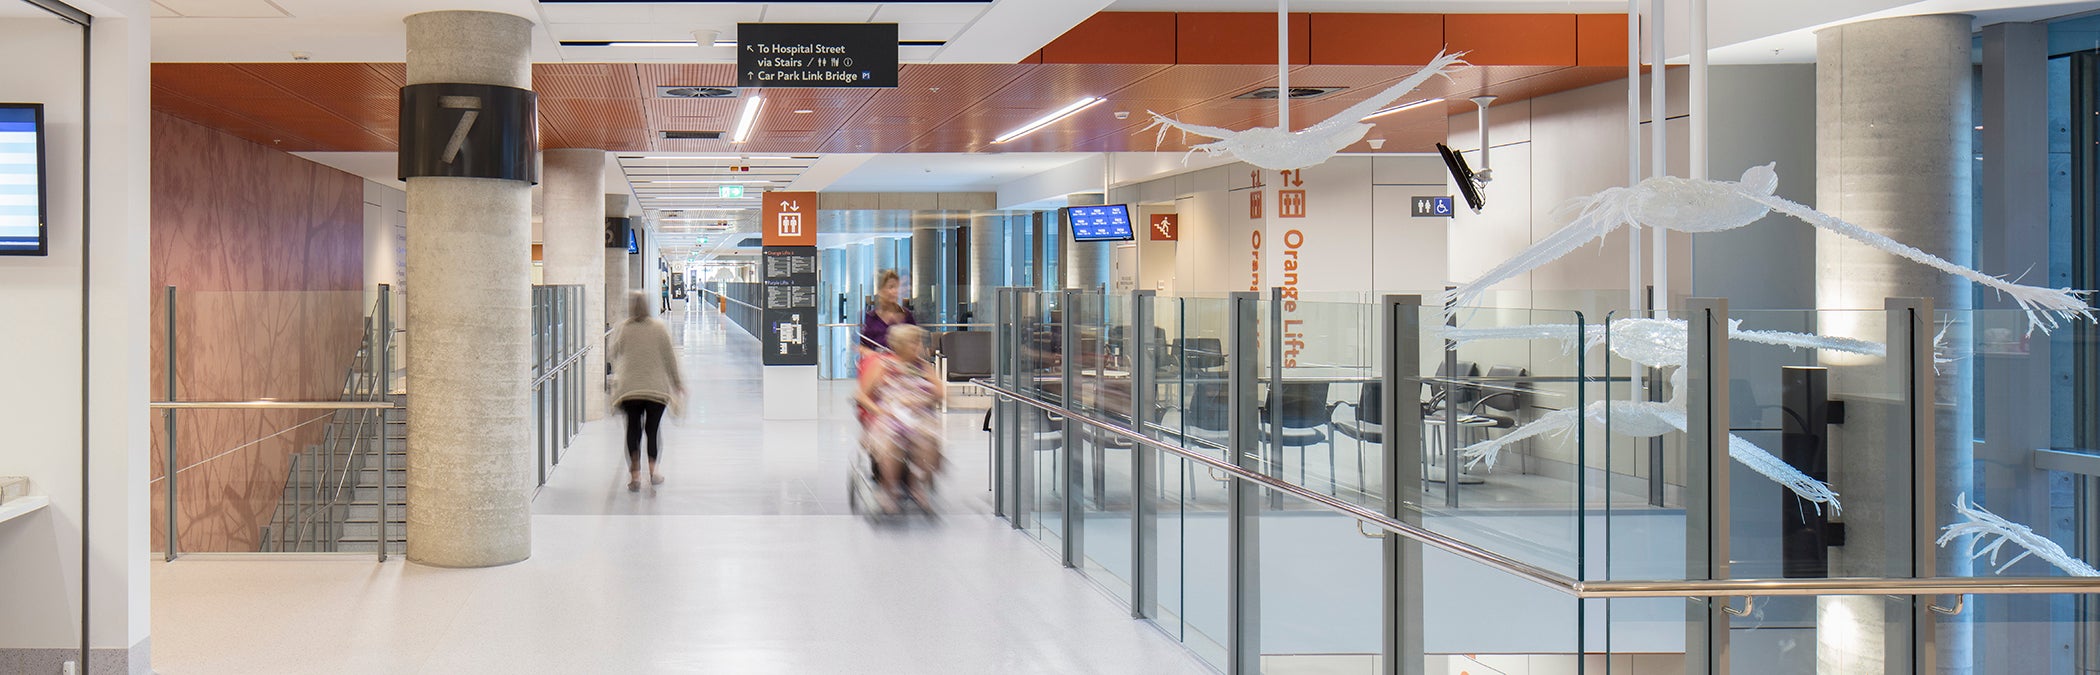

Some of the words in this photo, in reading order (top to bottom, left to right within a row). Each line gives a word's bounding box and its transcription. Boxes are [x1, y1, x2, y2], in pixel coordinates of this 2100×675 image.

[757, 44, 770, 53] To
[772, 43, 813, 56] Hospital
[815, 44, 846, 54] Street
[757, 57, 772, 67] via
[774, 57, 803, 67] Stairs
[757, 71, 775, 80] Car
[777, 71, 800, 80] Park
[802, 71, 823, 80] Link
[825, 71, 858, 83] Bridge
[440, 95, 481, 164] 7
[1281, 229, 1304, 312] Orange
[1284, 320, 1305, 369] Lifts
